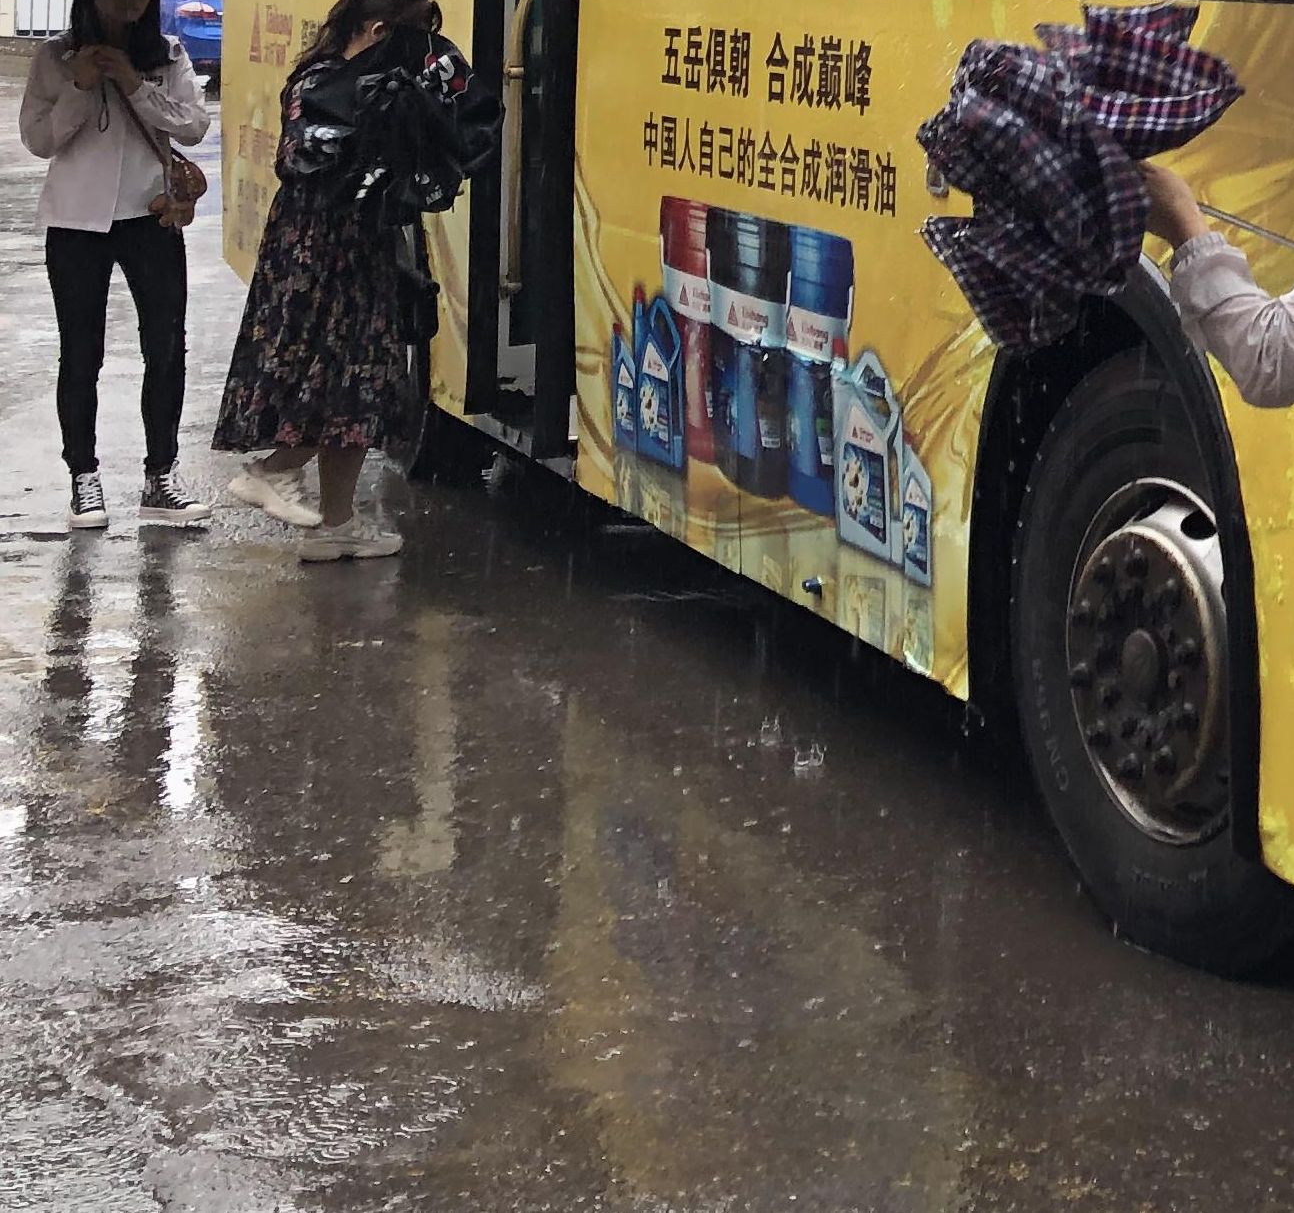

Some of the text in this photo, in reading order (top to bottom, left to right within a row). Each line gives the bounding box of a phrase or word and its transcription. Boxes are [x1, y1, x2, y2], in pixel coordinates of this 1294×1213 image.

[661, 25, 872, 116] 五岳俱朝 合成巅峰
[643, 111, 897, 218] 中国人自己的全合成润滑油
